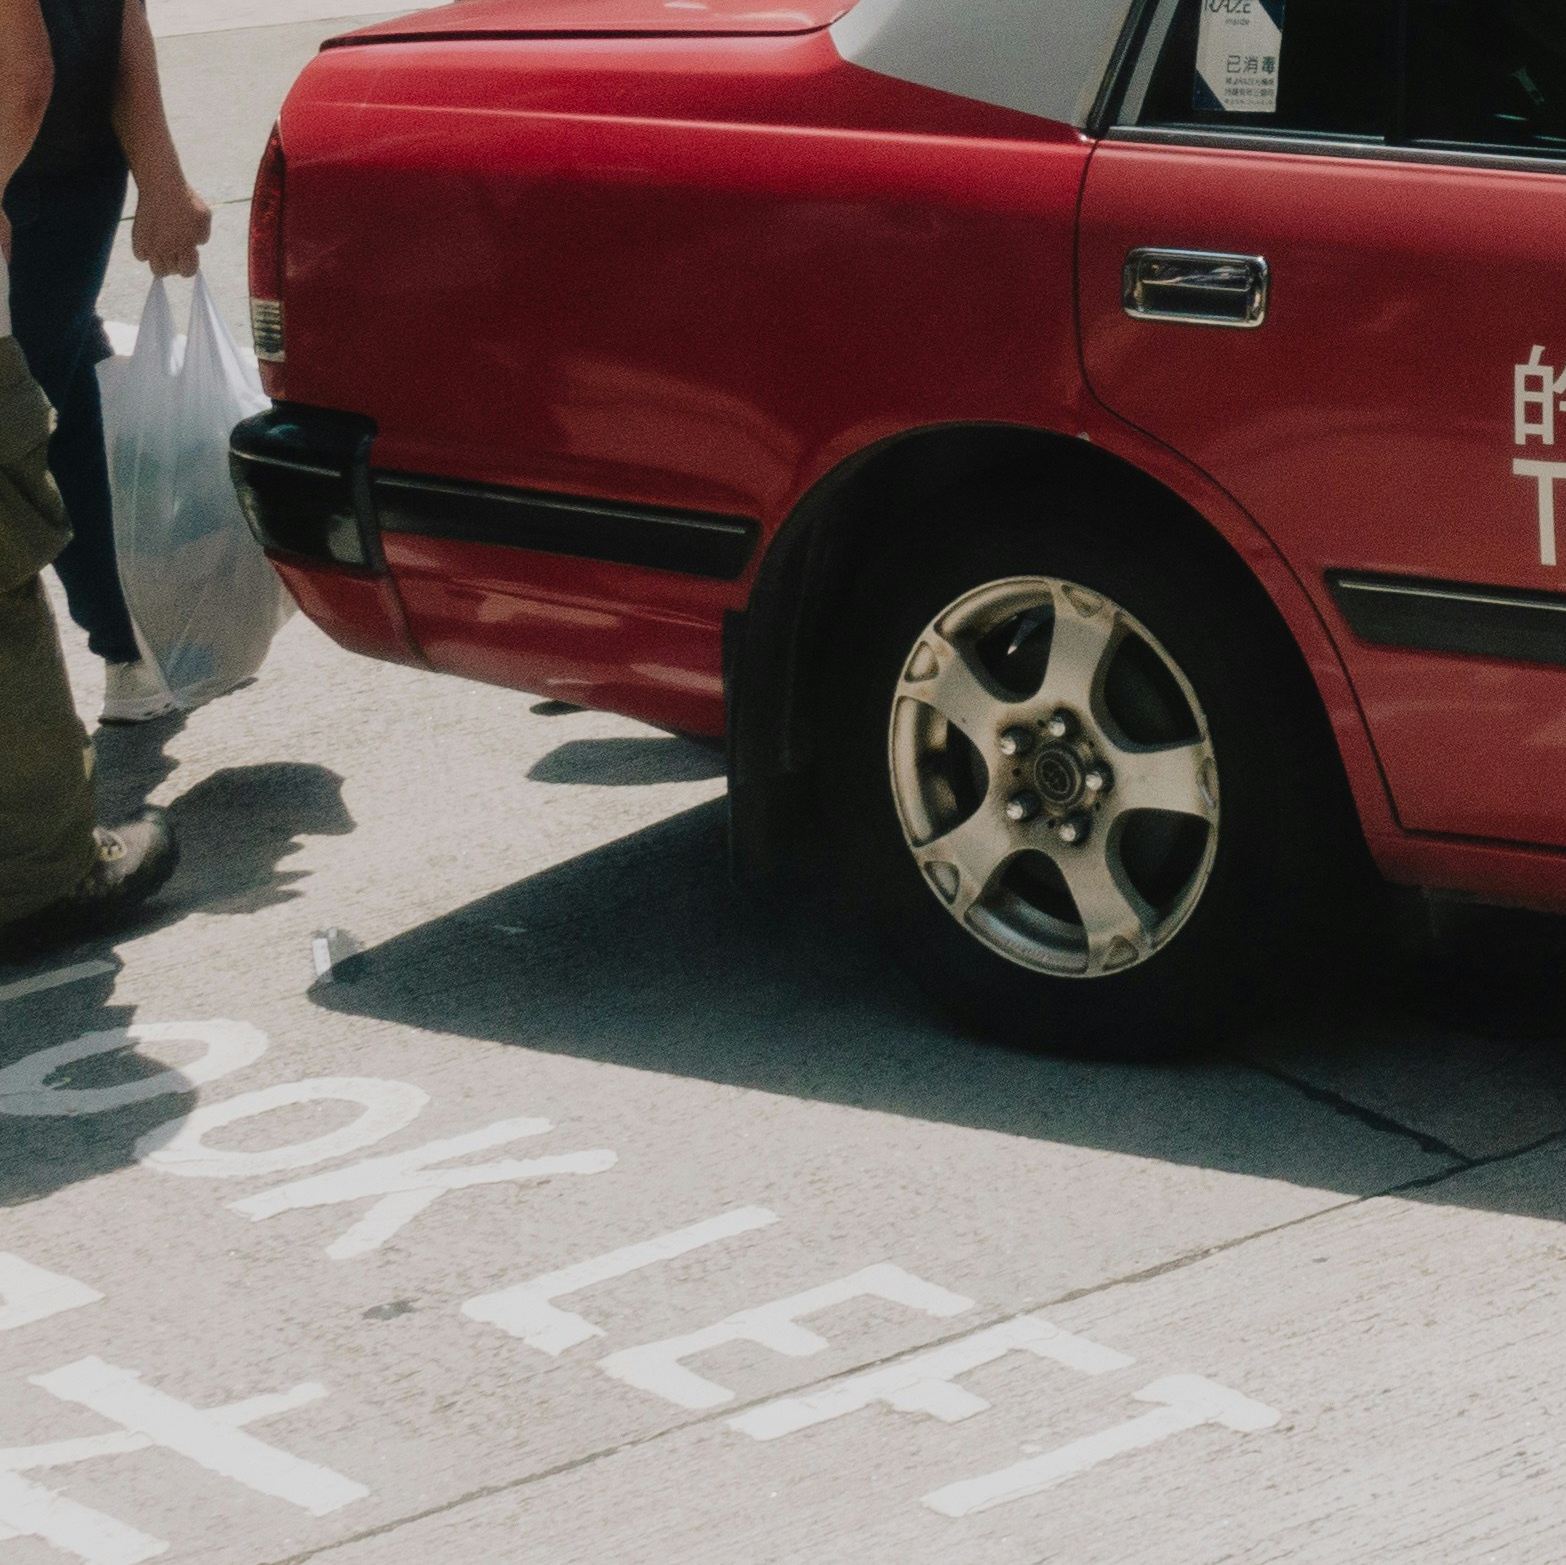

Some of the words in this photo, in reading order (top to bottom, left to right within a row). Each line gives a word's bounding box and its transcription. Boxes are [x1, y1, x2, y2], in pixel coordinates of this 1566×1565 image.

[1226, 55, 1275, 74] 已消毒
[460, 1205, 1283, 1518] LEFT
